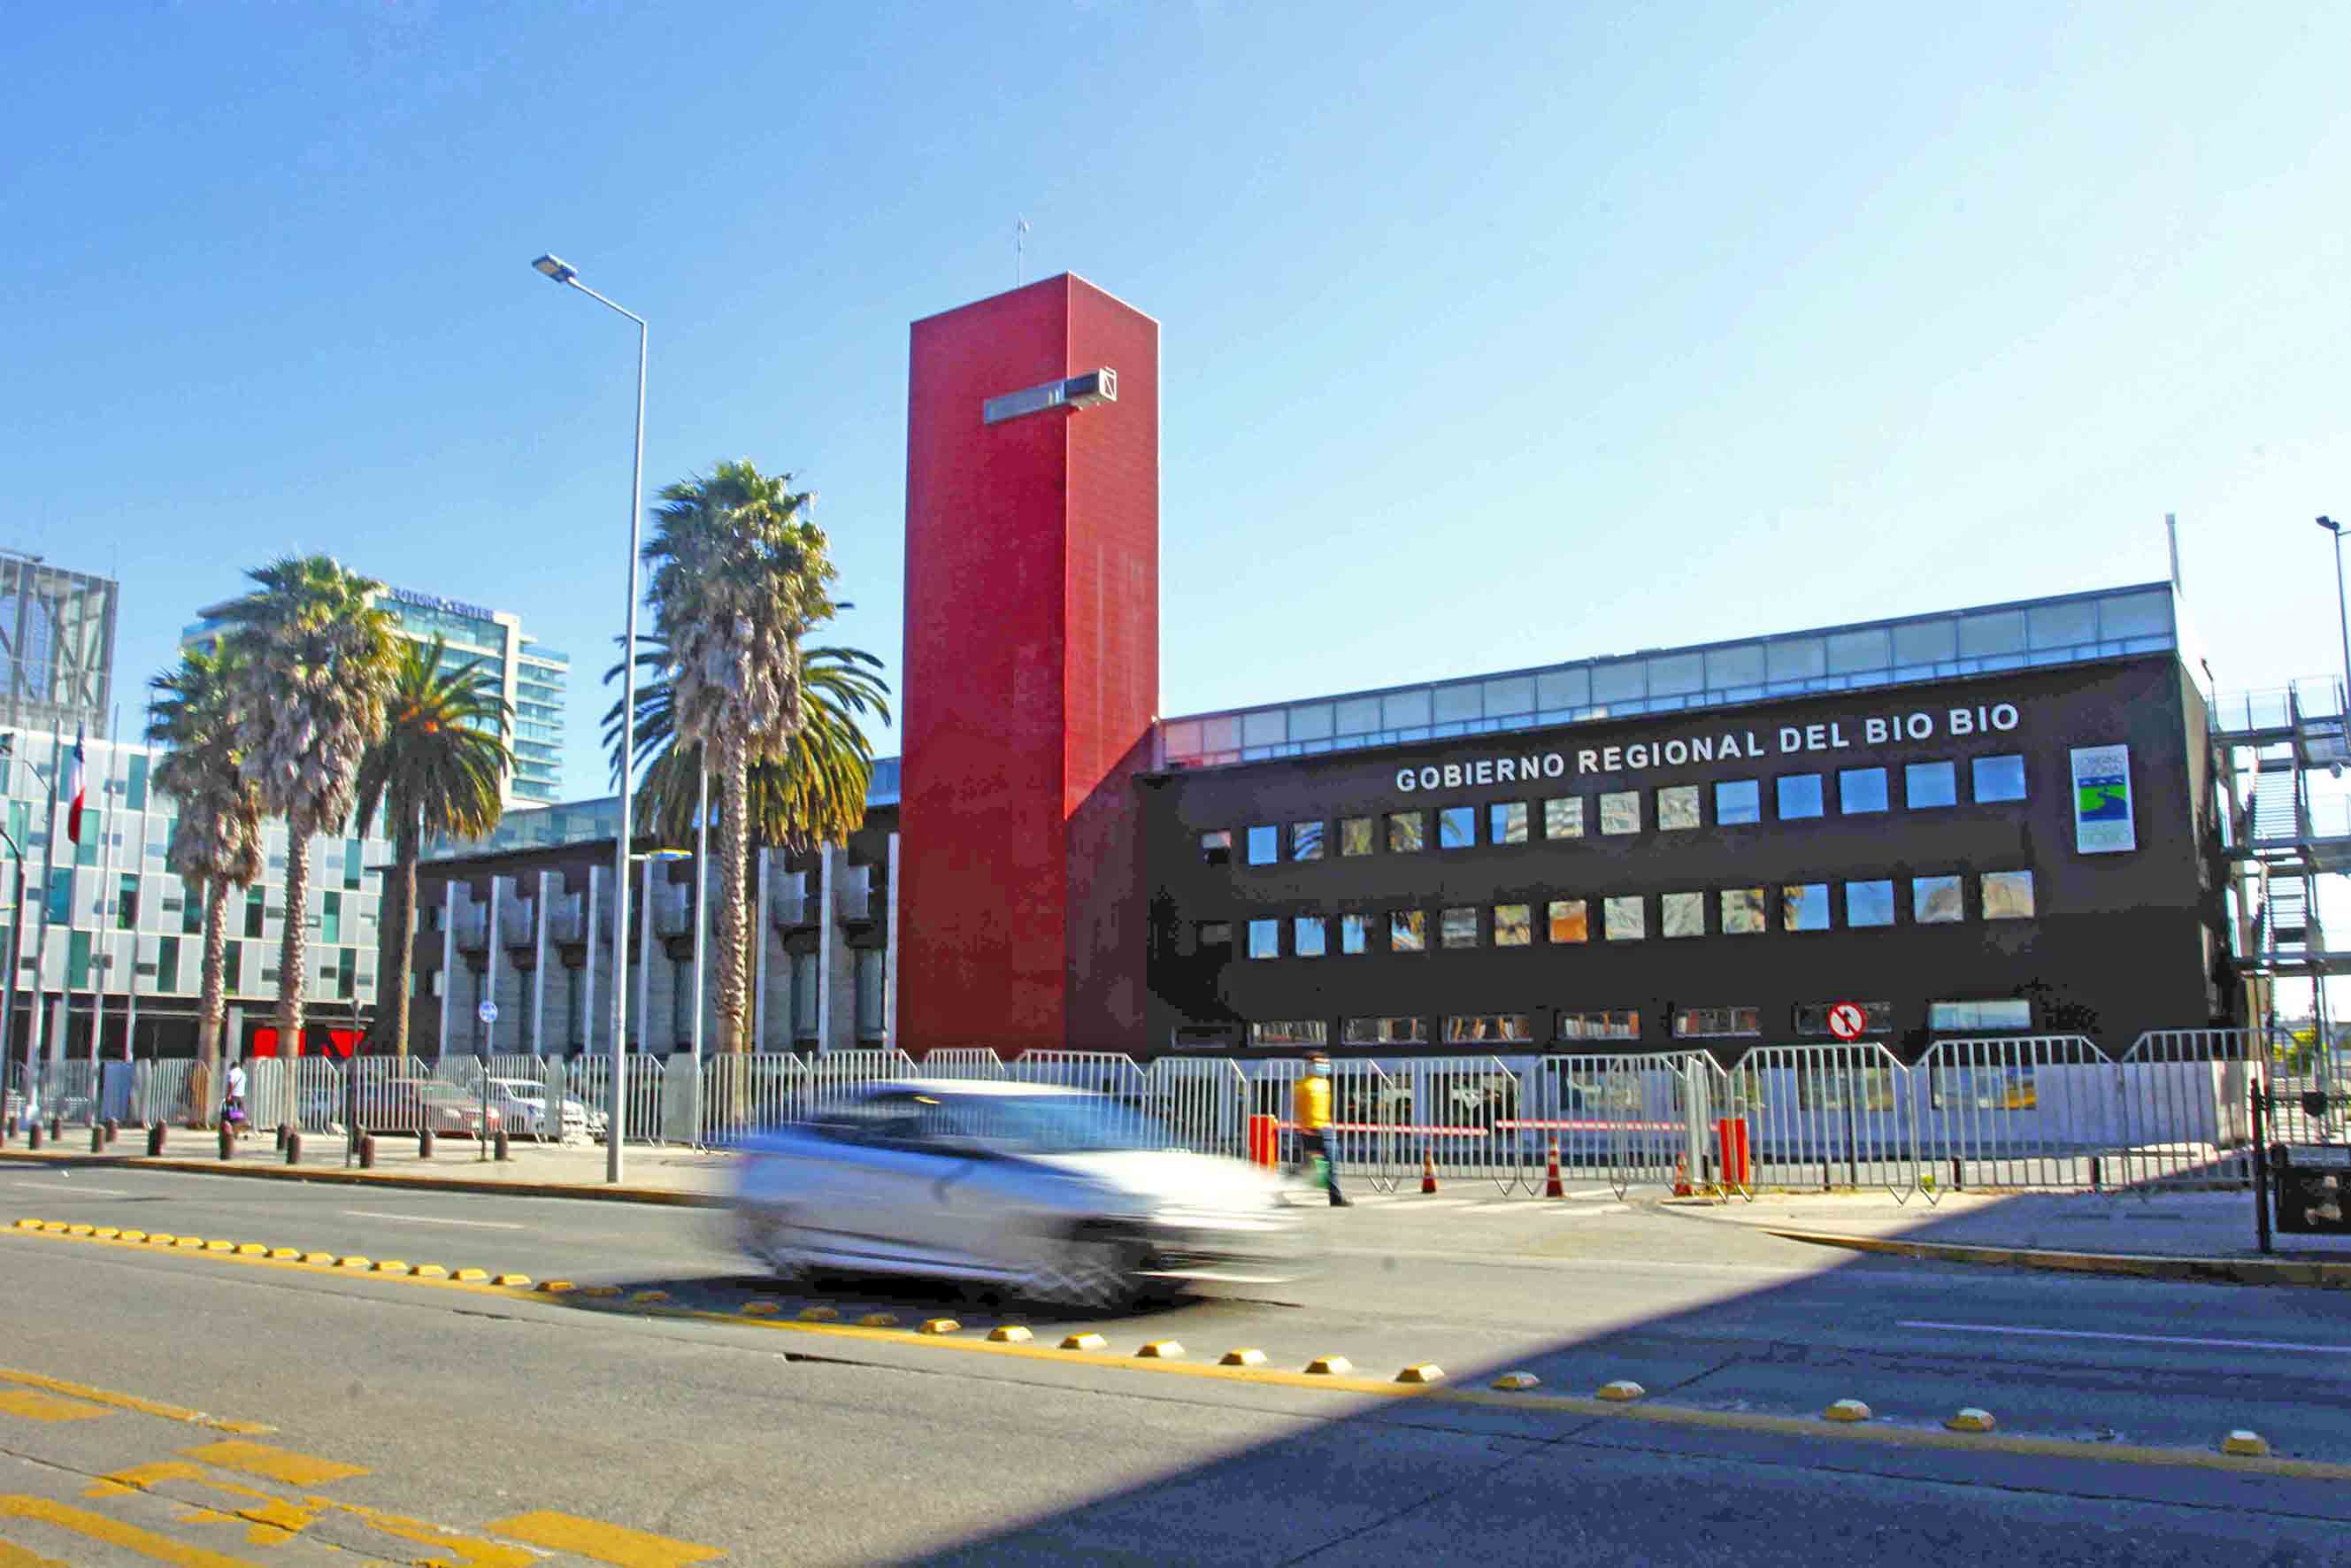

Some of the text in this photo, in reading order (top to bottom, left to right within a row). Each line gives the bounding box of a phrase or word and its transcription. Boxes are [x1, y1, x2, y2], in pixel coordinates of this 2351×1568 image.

[1396, 703, 2020, 792] GOBIERNO REGIONAL DEL BIO BIO
